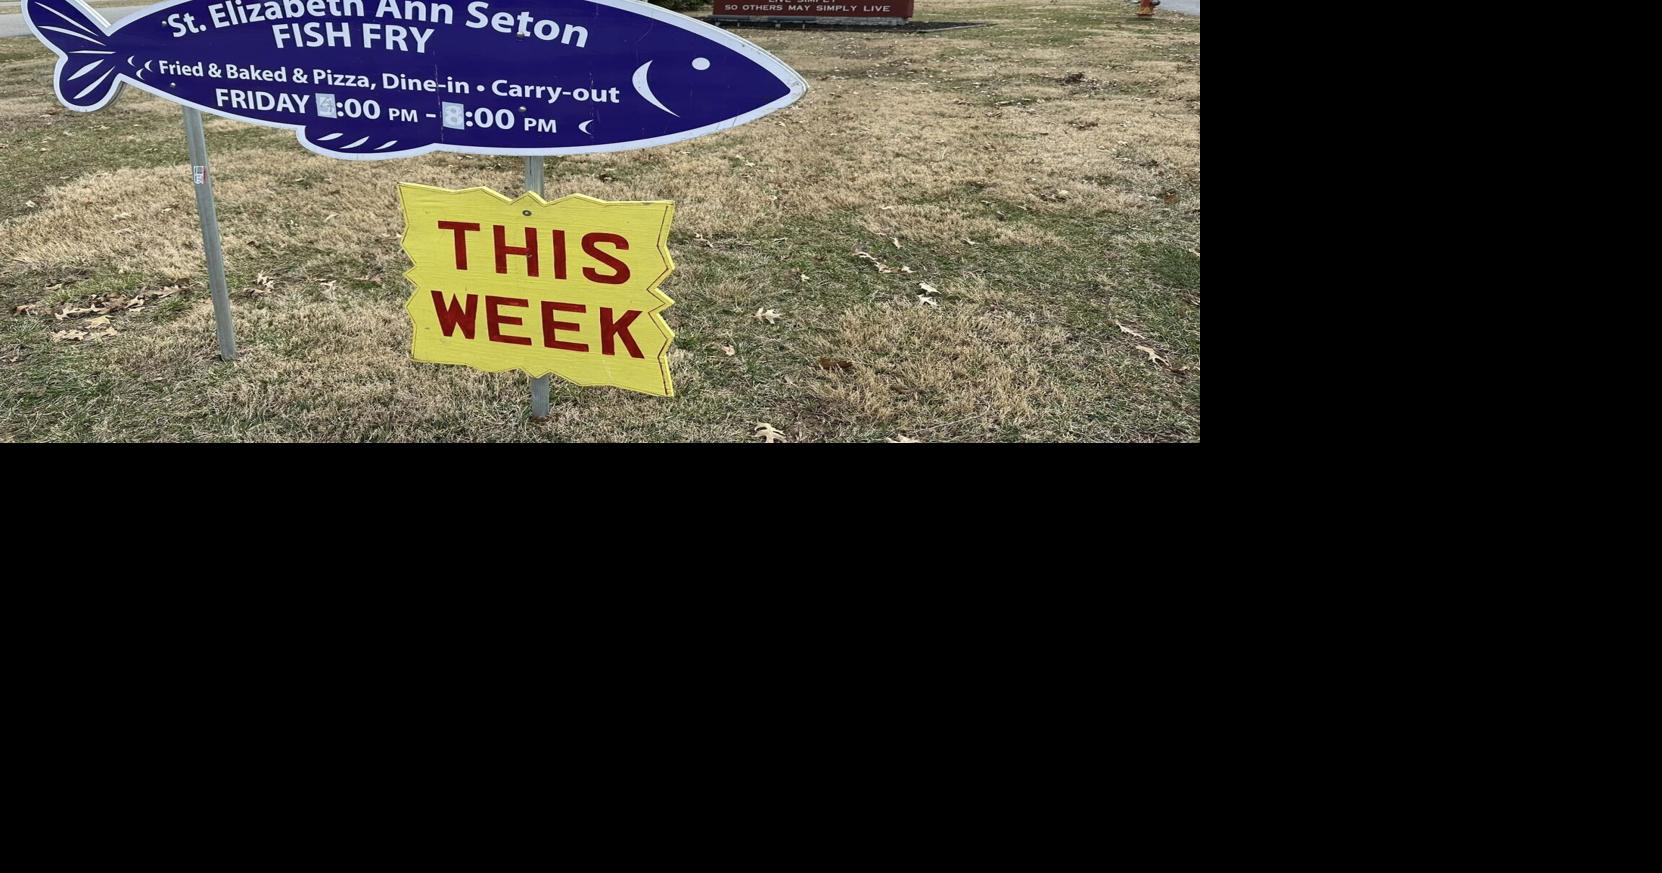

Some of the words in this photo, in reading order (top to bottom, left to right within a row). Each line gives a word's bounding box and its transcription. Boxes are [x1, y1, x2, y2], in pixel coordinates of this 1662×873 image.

[168, 13, 207, 38] St.
[208, 0, 364, 28] Elizabeth
[376, 0, 453, 24] Ann
[465, 2, 588, 48] Seton
[271, 22, 352, 49] FISH
[362, 23, 435, 54] FRY
[158, 60, 203, 78] Fried
[208, 63, 222, 77] &
[226, 64, 287, 82] Baked
[292, 68, 309, 83] &
[313, 69, 377, 91] Pizza,
[383, 72, 470, 94] Dine-in
[492, 79, 620, 107] Carry-out
[215, 88, 310, 114] FRIDAY
[388, 107, 418, 123] PM
[445, 104, 515, 130] 8:00
[524, 117, 557, 133] PM
[437, 220, 631, 285] THIS
[430, 290, 645, 359] WEEK
